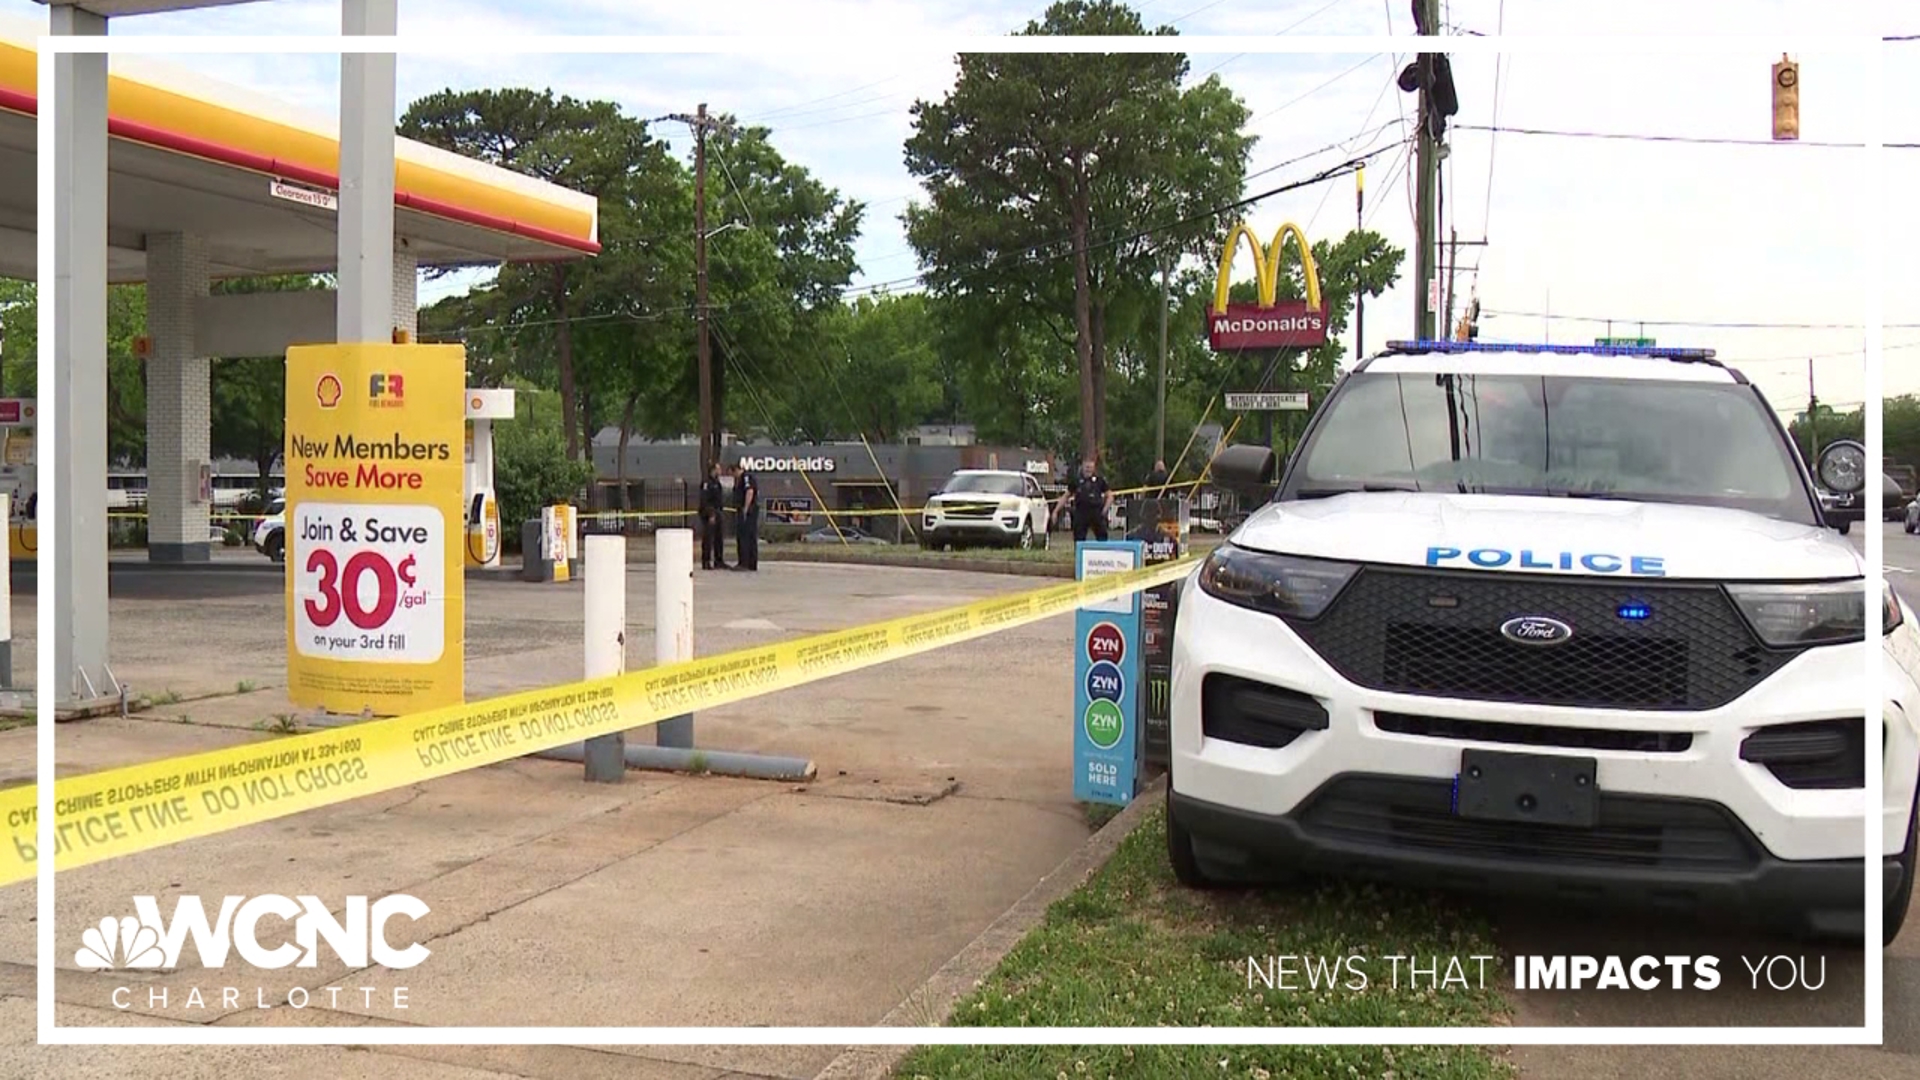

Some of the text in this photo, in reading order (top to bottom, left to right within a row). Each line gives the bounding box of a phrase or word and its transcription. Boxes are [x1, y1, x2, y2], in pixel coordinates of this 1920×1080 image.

[1213, 316, 1322, 334] McDonald's
[291, 433, 450, 460] New Members
[740, 456, 834, 472] McDonald's
[305, 463, 423, 489] Save More
[301, 516, 428, 543] Join & Save
[1426, 546, 1666, 577] POLICE
[1517, 622, 1555, 639] Ford
[314, 634, 405, 650] on your 3rd fill
[1092, 637, 1118, 652] ZYN
[1092, 676, 1118, 691] ZYN
[1091, 713, 1117, 729] ZYN
[1088, 761, 1117, 775] SOLD
[1088, 773, 1117, 787] HERE
